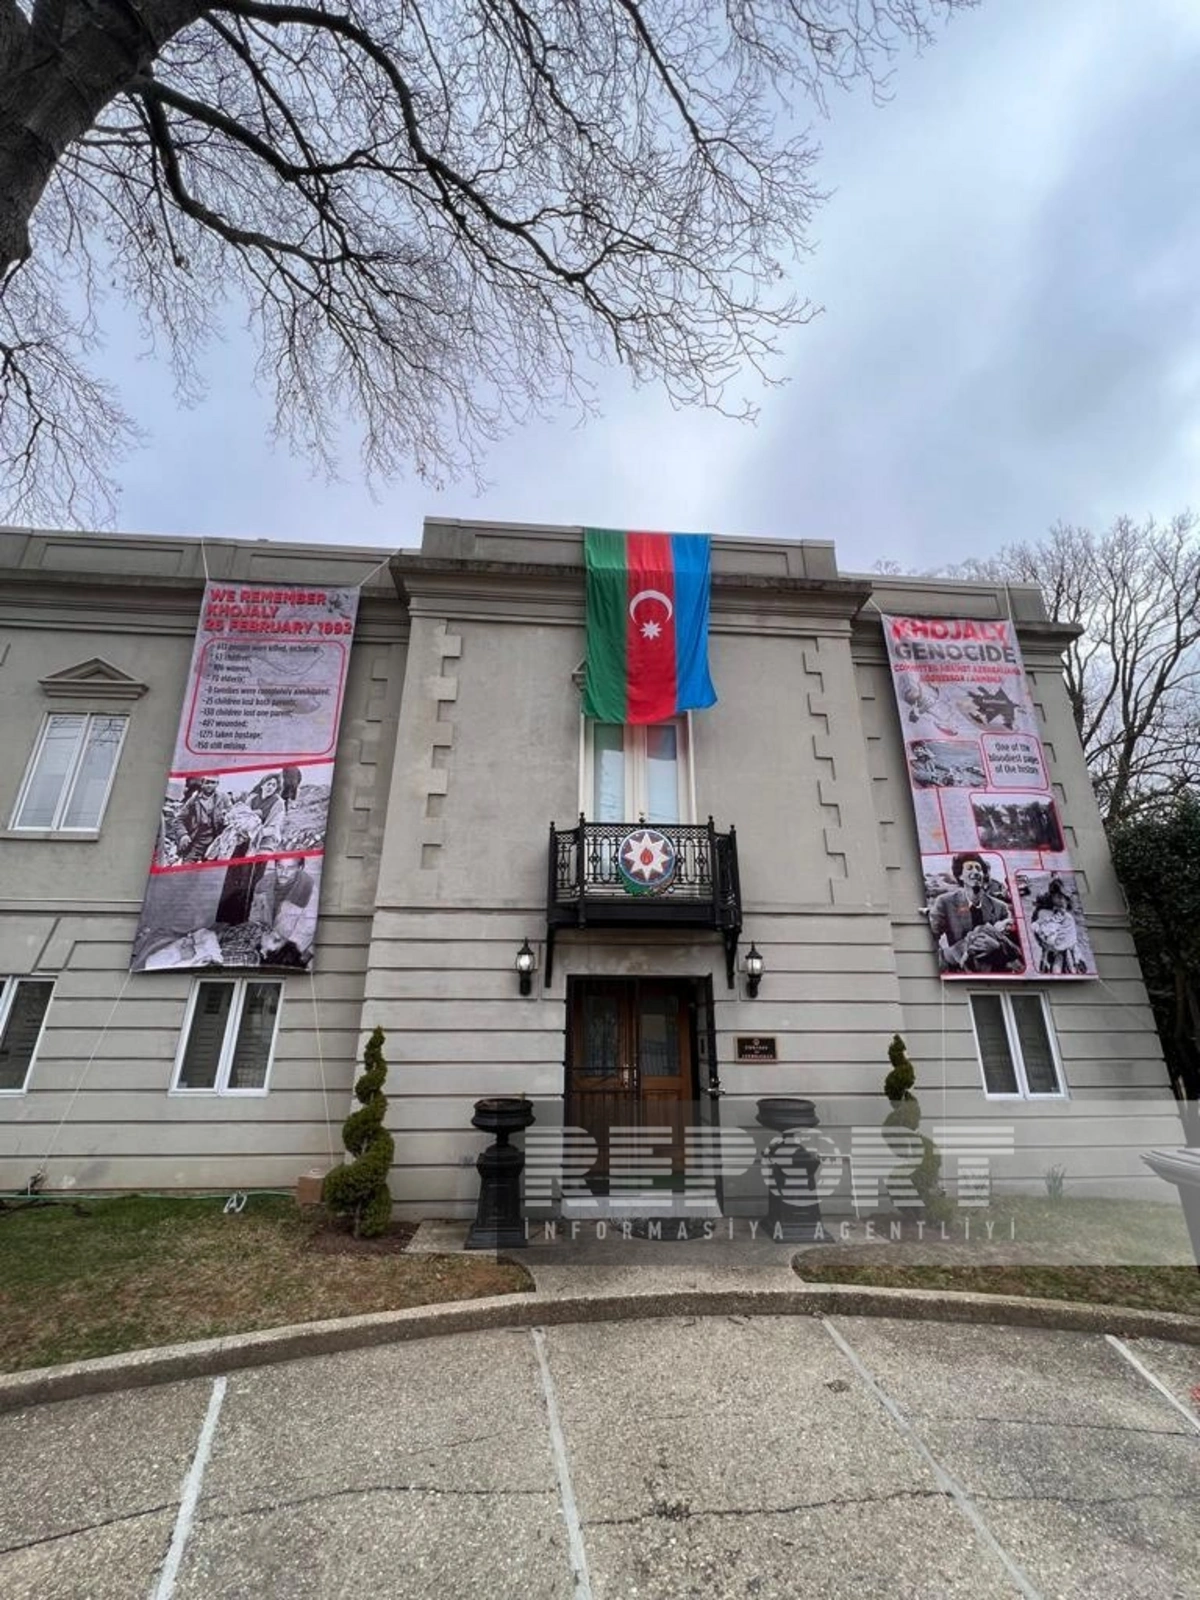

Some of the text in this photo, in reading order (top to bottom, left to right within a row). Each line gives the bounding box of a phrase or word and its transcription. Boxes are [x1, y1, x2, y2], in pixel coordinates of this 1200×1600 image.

[210, 589, 326, 605] WE REMEMBER
[207, 604, 278, 618] KHOJALY
[229, 620, 313, 634] FEBRUARY
[319, 621, 352, 635] 1992
[892, 619, 1008, 641] KHOJALY
[894, 642, 1017, 664] GENOCIDE
